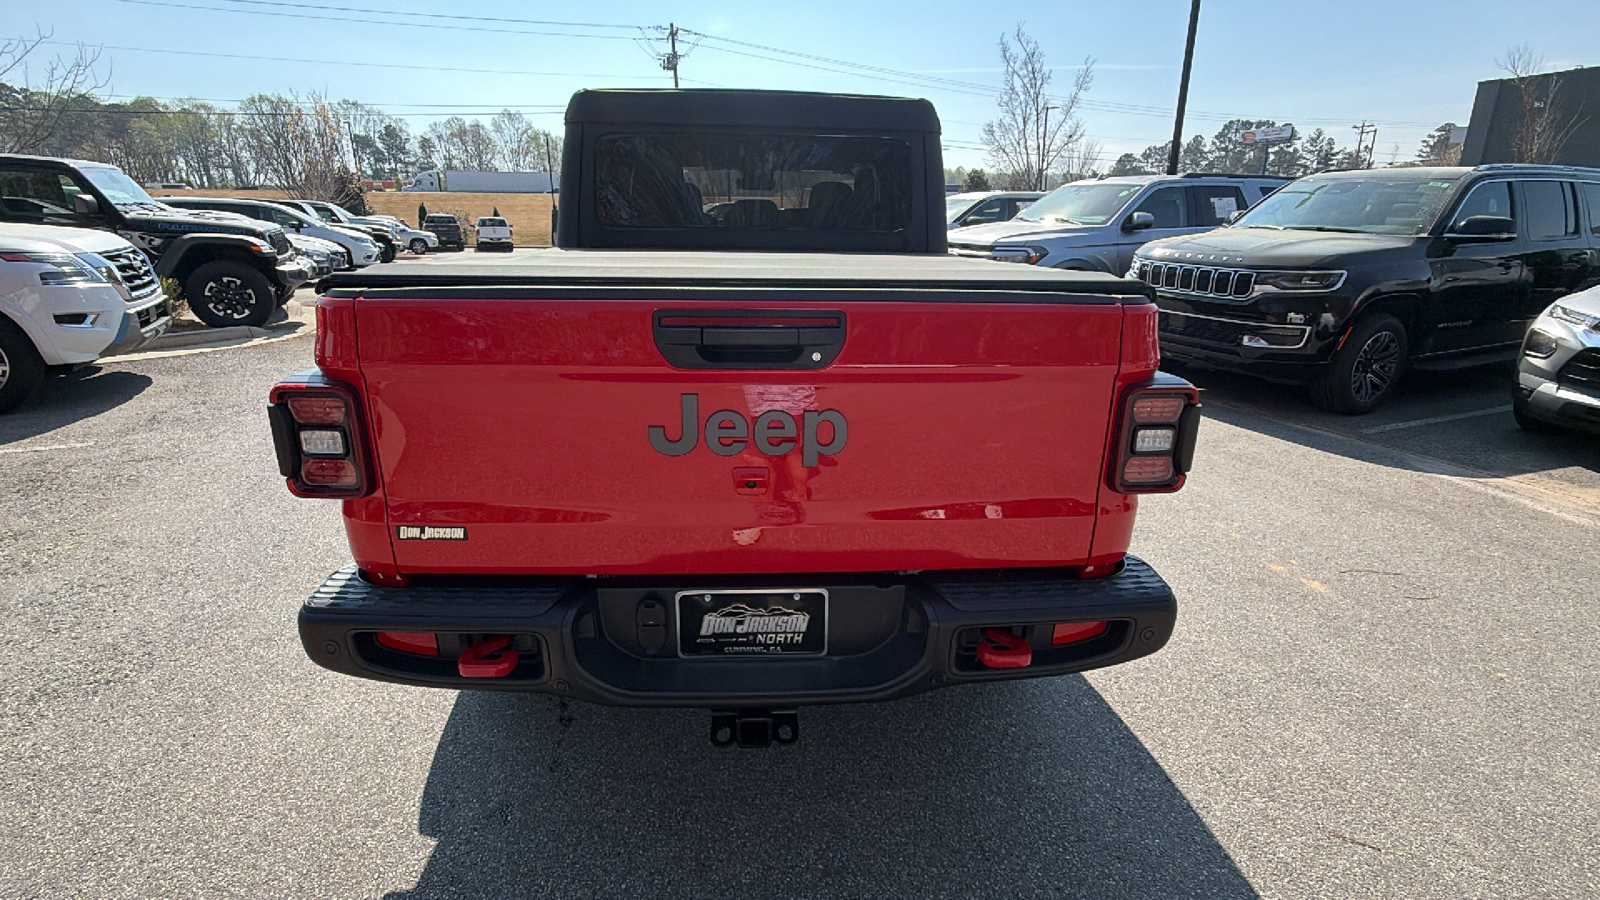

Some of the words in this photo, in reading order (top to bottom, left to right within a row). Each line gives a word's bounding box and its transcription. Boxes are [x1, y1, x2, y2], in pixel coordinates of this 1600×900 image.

[1151, 248, 1243, 261] AGONEER
[648, 393, 848, 467] Jeep
[399, 526, 420, 539] DON
[421, 526, 465, 539] JACKSON
[699, 614, 737, 636] DON
[736, 614, 811, 634] JACKSON
[756, 633, 804, 644] NORTH
